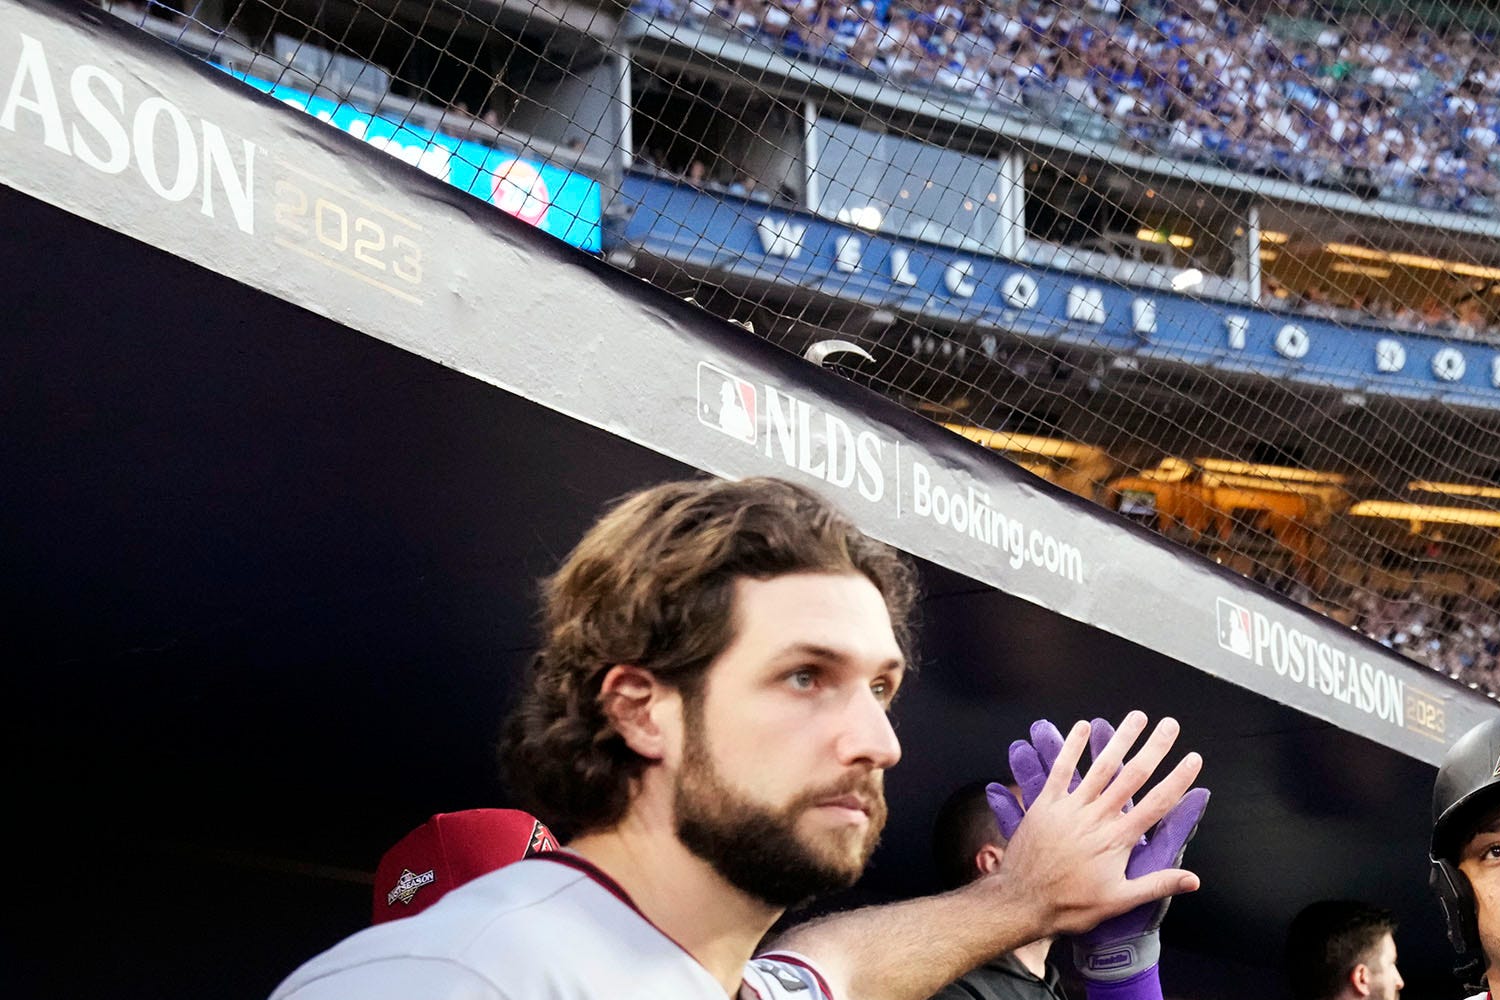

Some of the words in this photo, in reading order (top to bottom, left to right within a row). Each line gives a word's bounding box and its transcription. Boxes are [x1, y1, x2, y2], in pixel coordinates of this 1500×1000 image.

[0, 32, 257, 235] ASON
[275, 177, 424, 285] 2023
[757, 215, 1158, 334] WELCOME
[1225, 314, 1311, 359] TO
[764, 384, 886, 504] NLDS
[913, 462, 1084, 584] Booking.com
[1253, 610, 1405, 728] POSTSEASON
